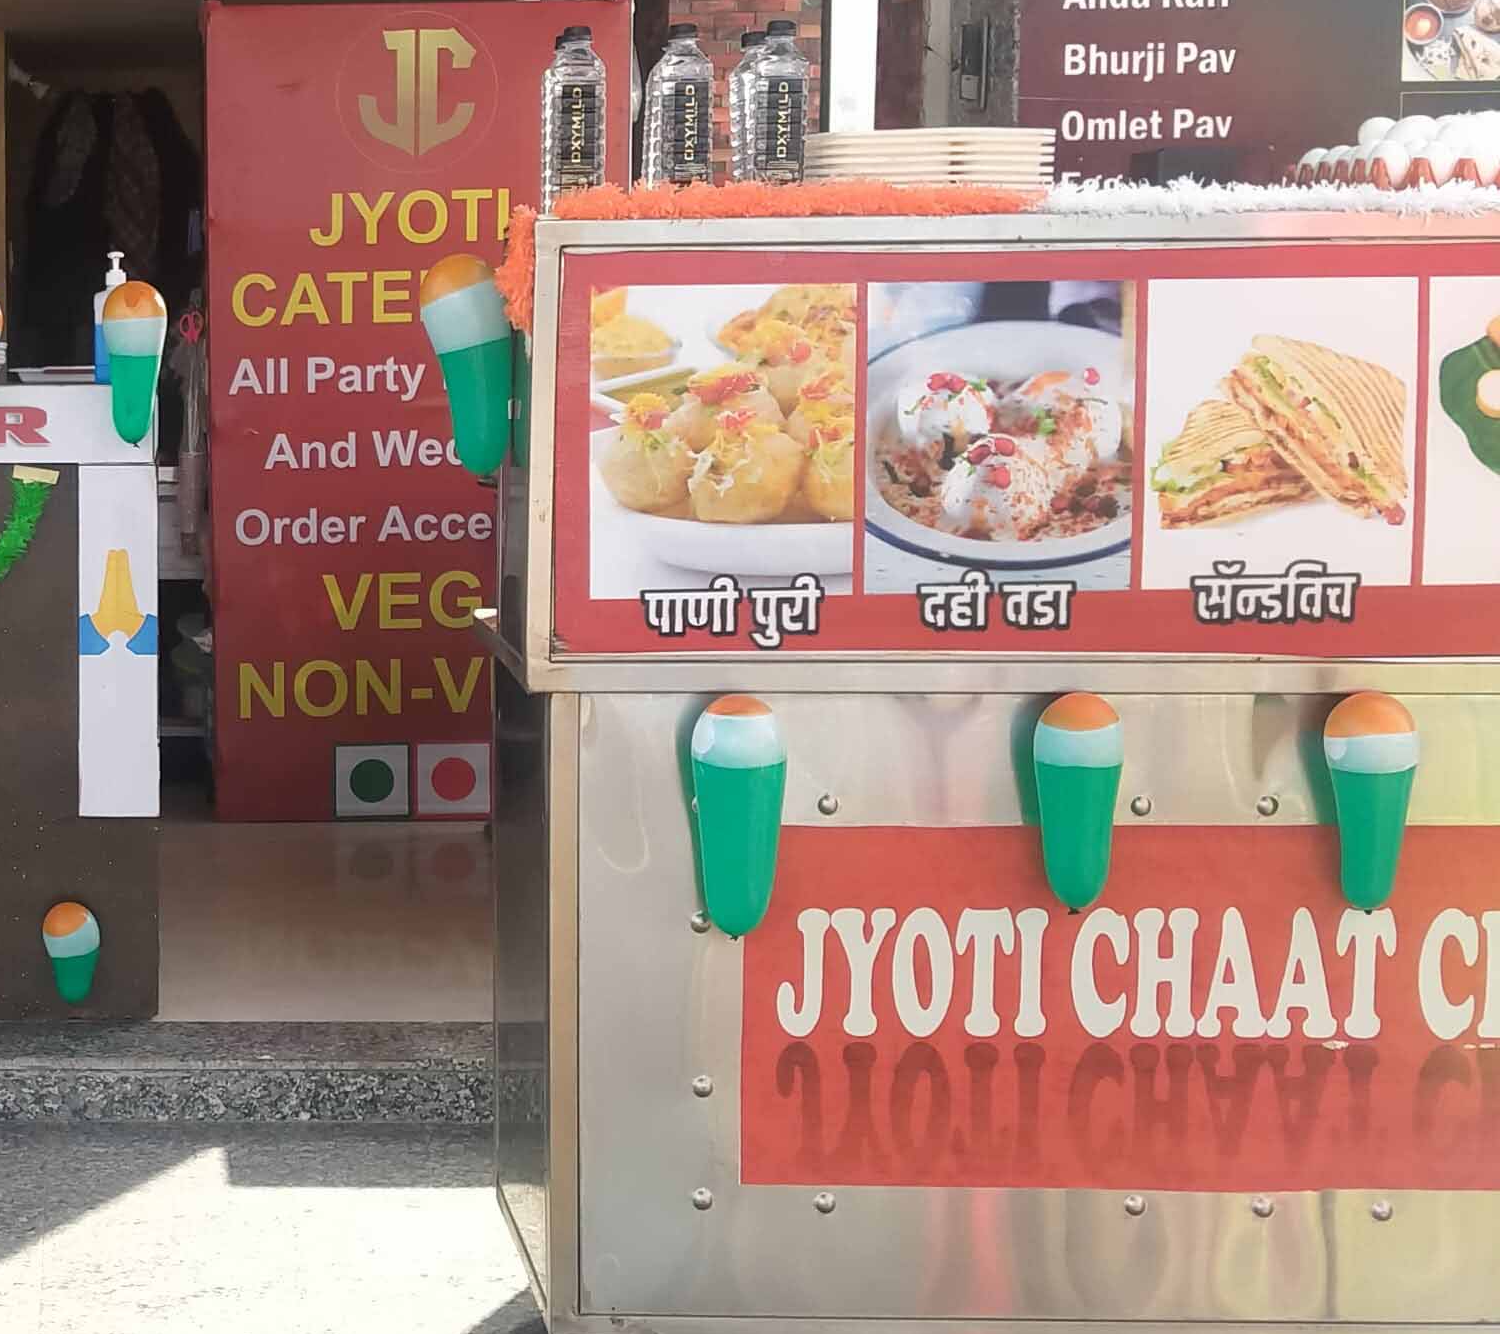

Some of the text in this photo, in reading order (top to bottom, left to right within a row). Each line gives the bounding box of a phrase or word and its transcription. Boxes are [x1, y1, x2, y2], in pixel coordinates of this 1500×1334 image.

[1063, 41, 1237, 83] Bhurji Pav
[1060, 107, 1233, 142] Omlet Pav
[308, 187, 510, 247] JYOTI
[231, 269, 428, 327] CATE
[228, 355, 426, 402] All Party
[264, 432, 357, 470] And
[234, 505, 493, 546] Order Acce
[321, 570, 484, 632] VEG
[643, 574, 823, 647] पाणी पुरी
[920, 571, 992, 628] दही
[236, 656, 494, 720] NON-V
[775, 907, 1049, 1039] JYOTI
[1069, 907, 1398, 1040] CHAAT
